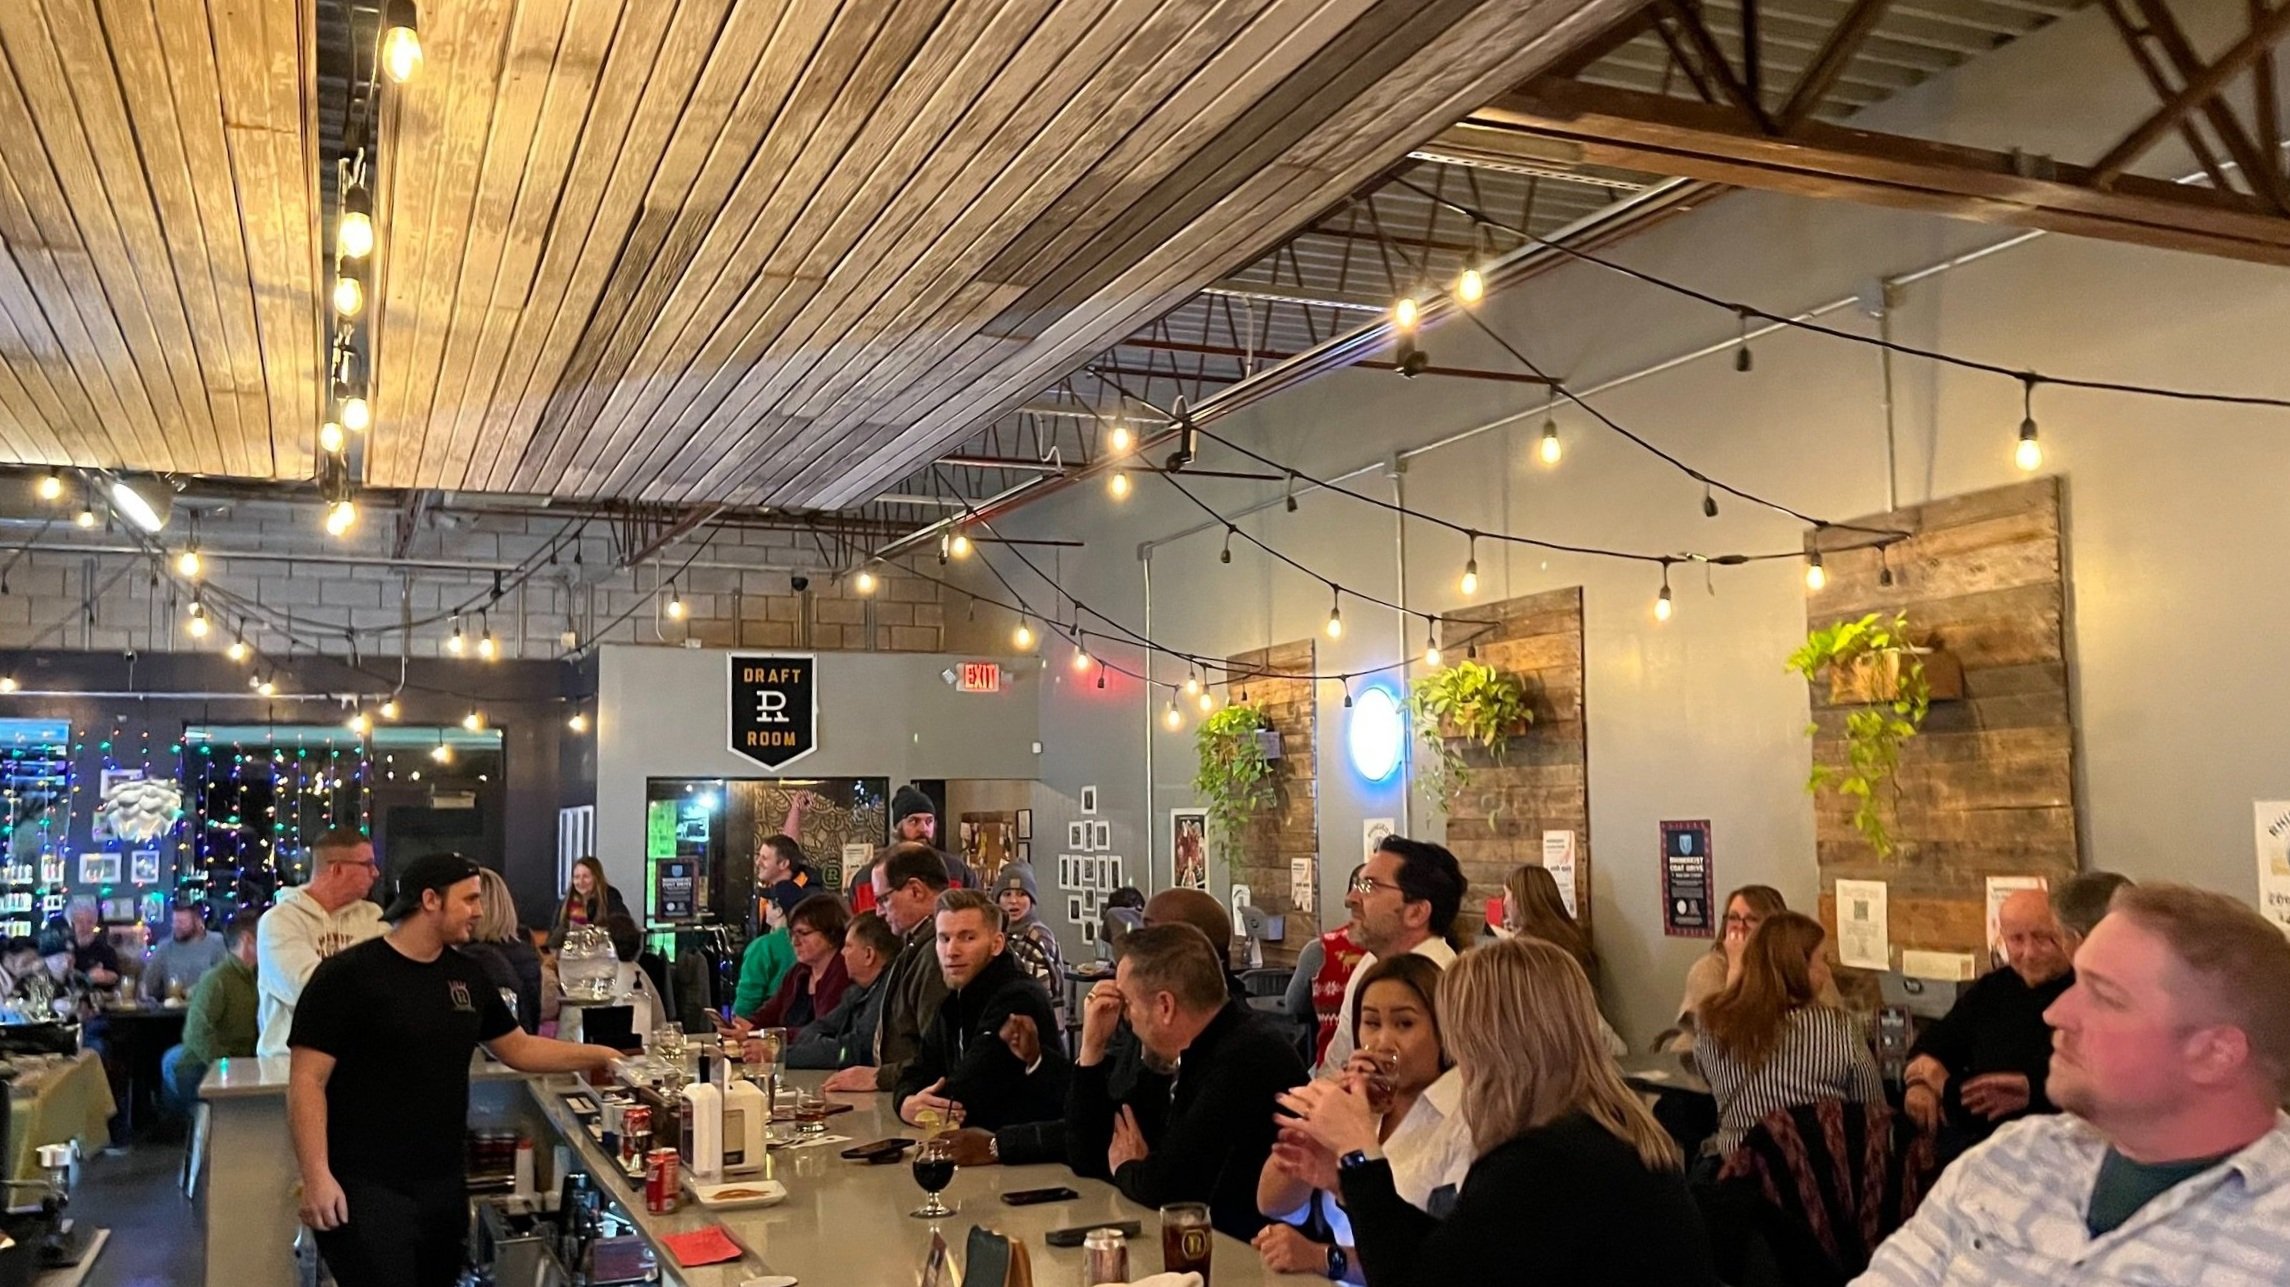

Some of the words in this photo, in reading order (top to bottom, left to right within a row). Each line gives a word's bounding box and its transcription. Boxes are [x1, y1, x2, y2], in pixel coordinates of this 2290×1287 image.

[743, 668, 801, 683] DRAFT
[965, 664, 995, 689] EXIT
[756, 690, 790, 722] R
[747, 731, 796, 746] ROOM
